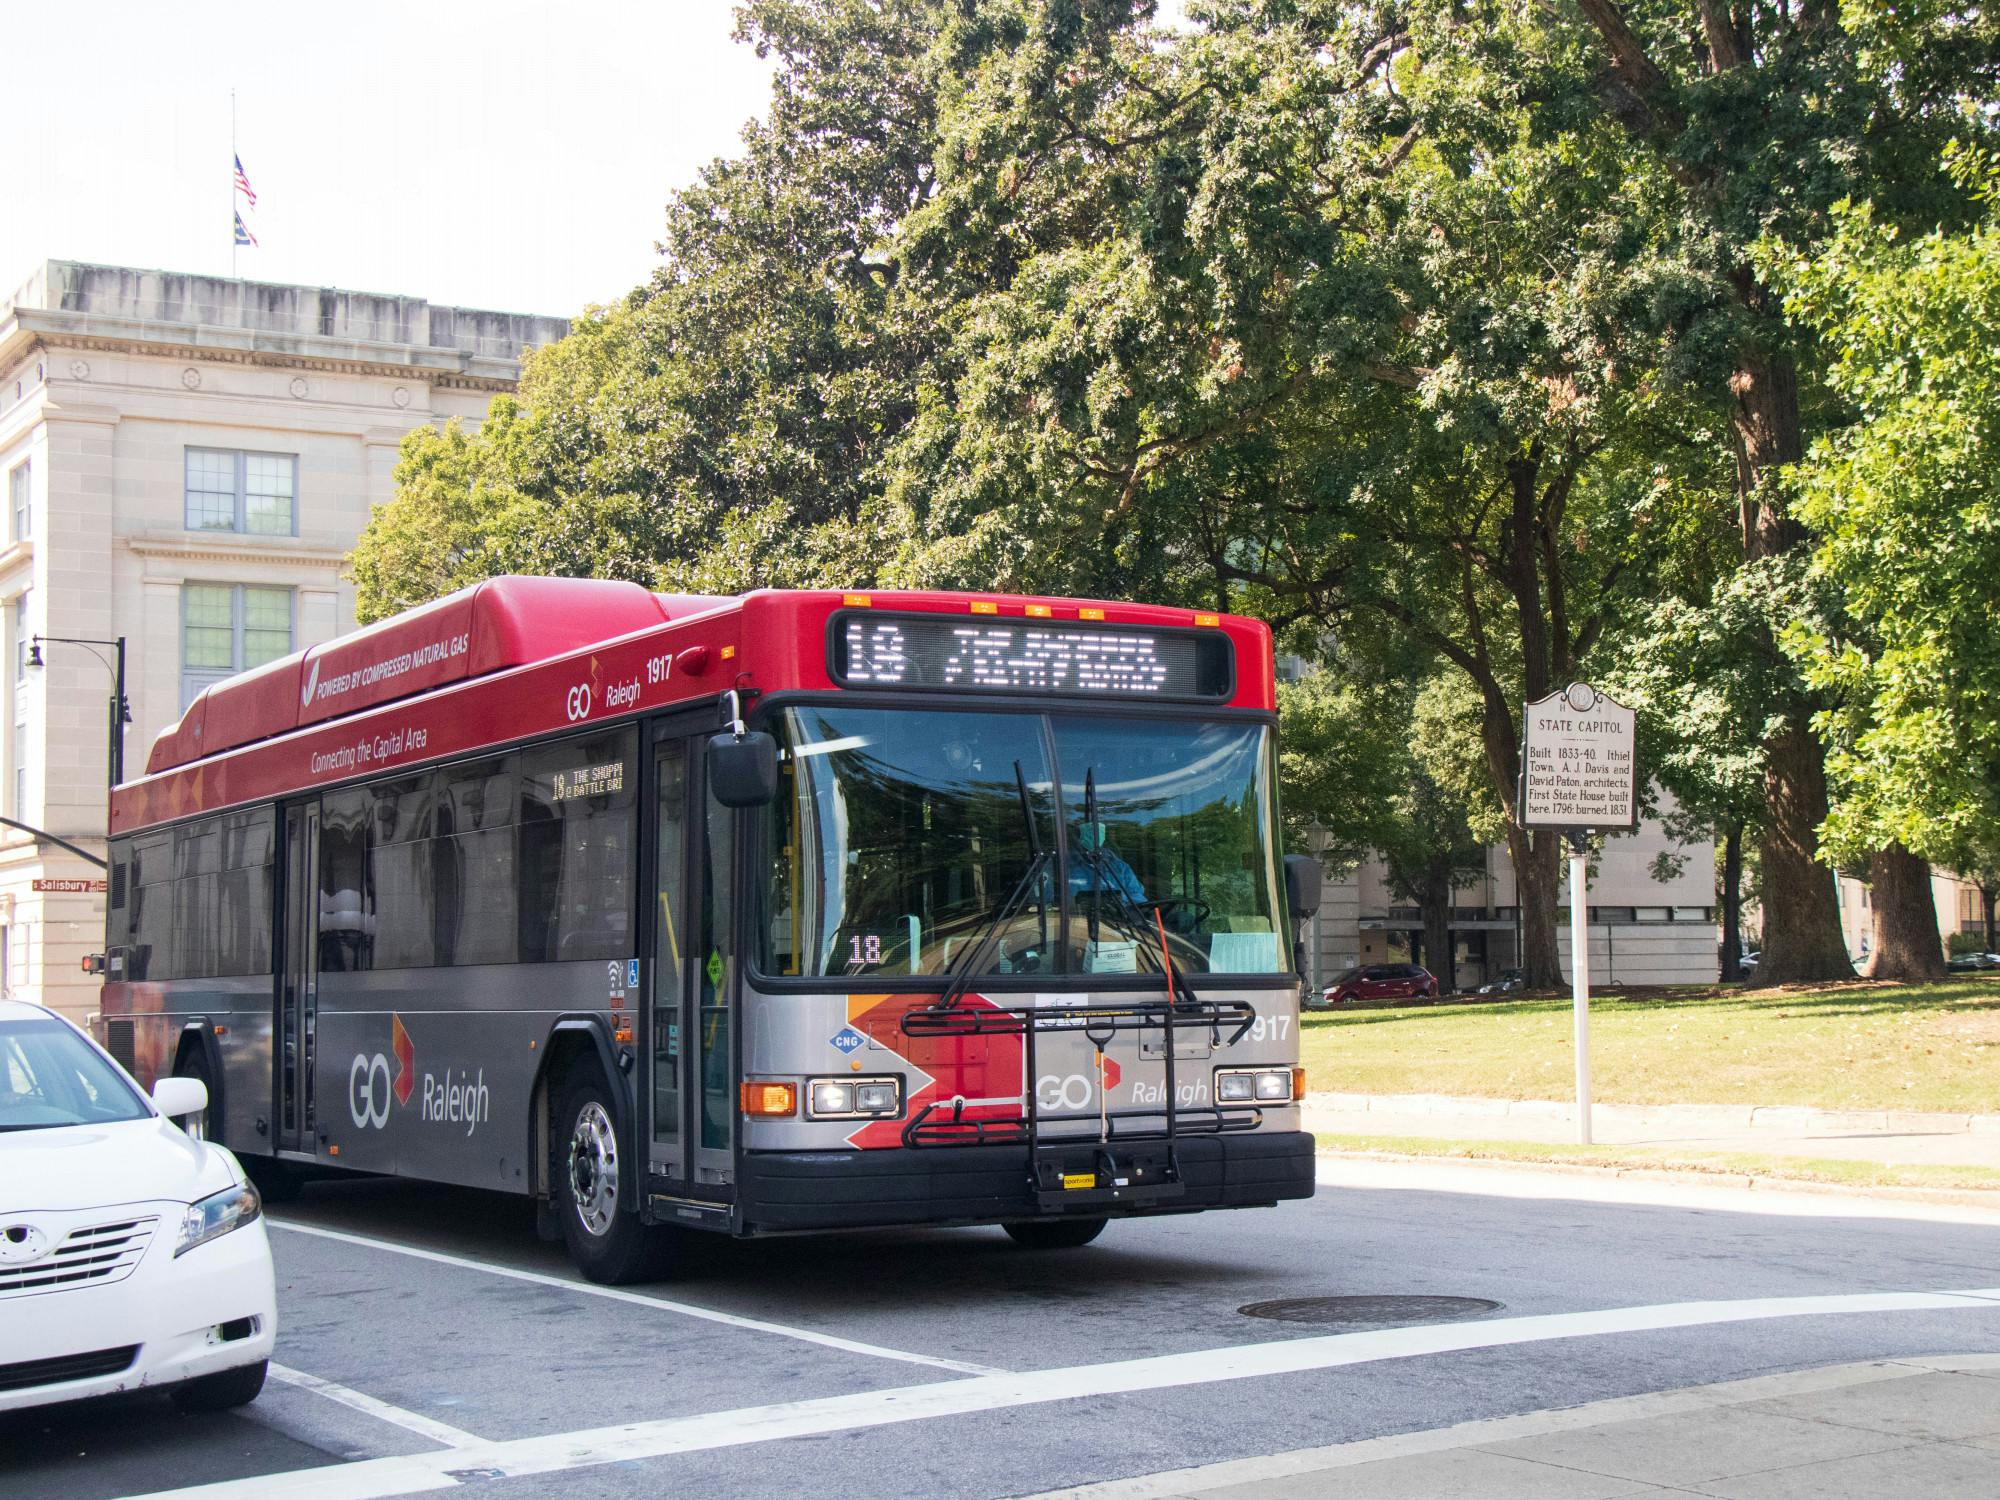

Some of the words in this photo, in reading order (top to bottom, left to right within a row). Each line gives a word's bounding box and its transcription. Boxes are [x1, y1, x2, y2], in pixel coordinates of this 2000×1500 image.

[317, 674, 351, 699] POWERED
[351, 669, 362, 689] BY
[362, 653, 411, 686] COMPRESSED
[412, 640, 449, 668] NATURAL
[451, 633, 469, 657] GAS
[646, 654, 673, 684] 1917
[567, 683, 591, 721] GO
[605, 675, 640, 708] Raleigh
[1538, 719, 1573, 732] STATE
[1578, 721, 1622, 734] CAPITOL
[311, 746, 355, 774] Connecting
[357, 738, 372, 763] the
[373, 728, 404, 763] Capital
[404, 728, 427, 752] Area
[1530, 746, 1551, 759] Built
[1607, 750, 1630, 761] Ithiel
[573, 769, 590, 784] THE
[1562, 762, 1571, 773] A.
[1574, 762, 1580, 773] J.
[1585, 763, 1609, 774] Davis
[1613, 764, 1630, 775] and
[573, 780, 605, 797] BATTLE
[1529, 775, 1554, 786] David
[1529, 789, 1553, 800] First
[1553, 789, 1577, 800] State
[1580, 790, 1606, 801] House
[1609, 790, 1629, 802] built
[40, 880, 87, 892] Salisbury
[849, 935, 880, 963] 18
[836, 1036, 858, 1047] CNG
[350, 1053, 391, 1129] GO
[422, 1066, 489, 1137] Raleigh
[1035, 1074, 1092, 1110] GO
